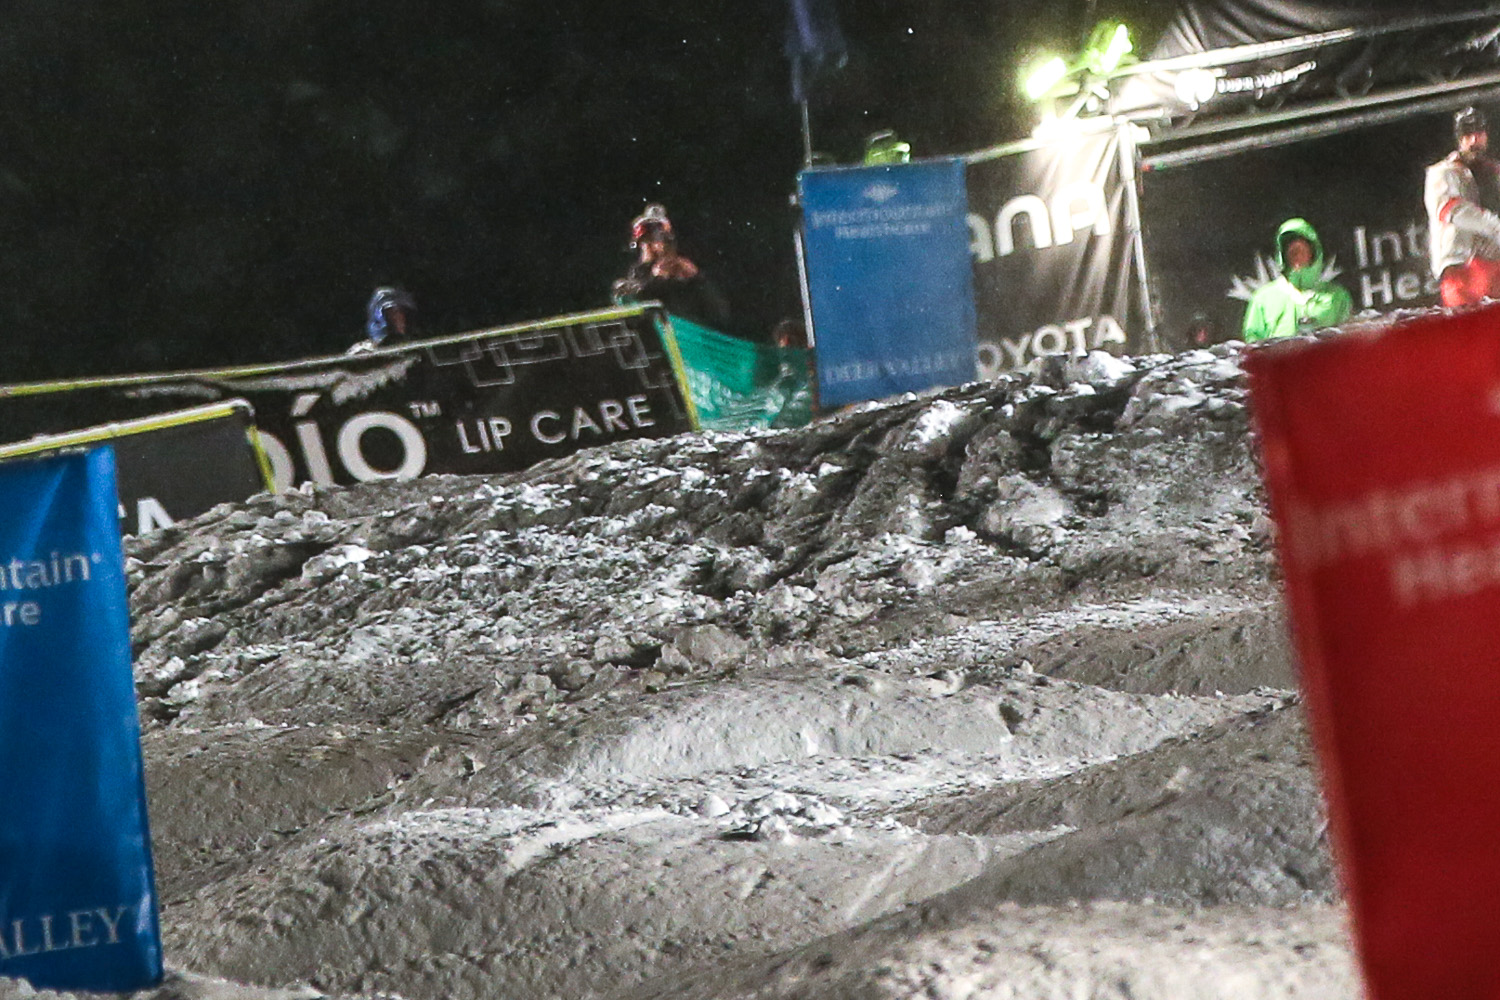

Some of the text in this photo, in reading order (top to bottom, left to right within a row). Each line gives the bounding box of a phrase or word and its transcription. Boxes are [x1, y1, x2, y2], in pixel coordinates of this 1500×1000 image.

[976, 314, 1127, 378] OYOTA
[456, 416, 513, 454] LIP
[529, 394, 657, 445] CARE
[0, 906, 127, 959] LLEY
